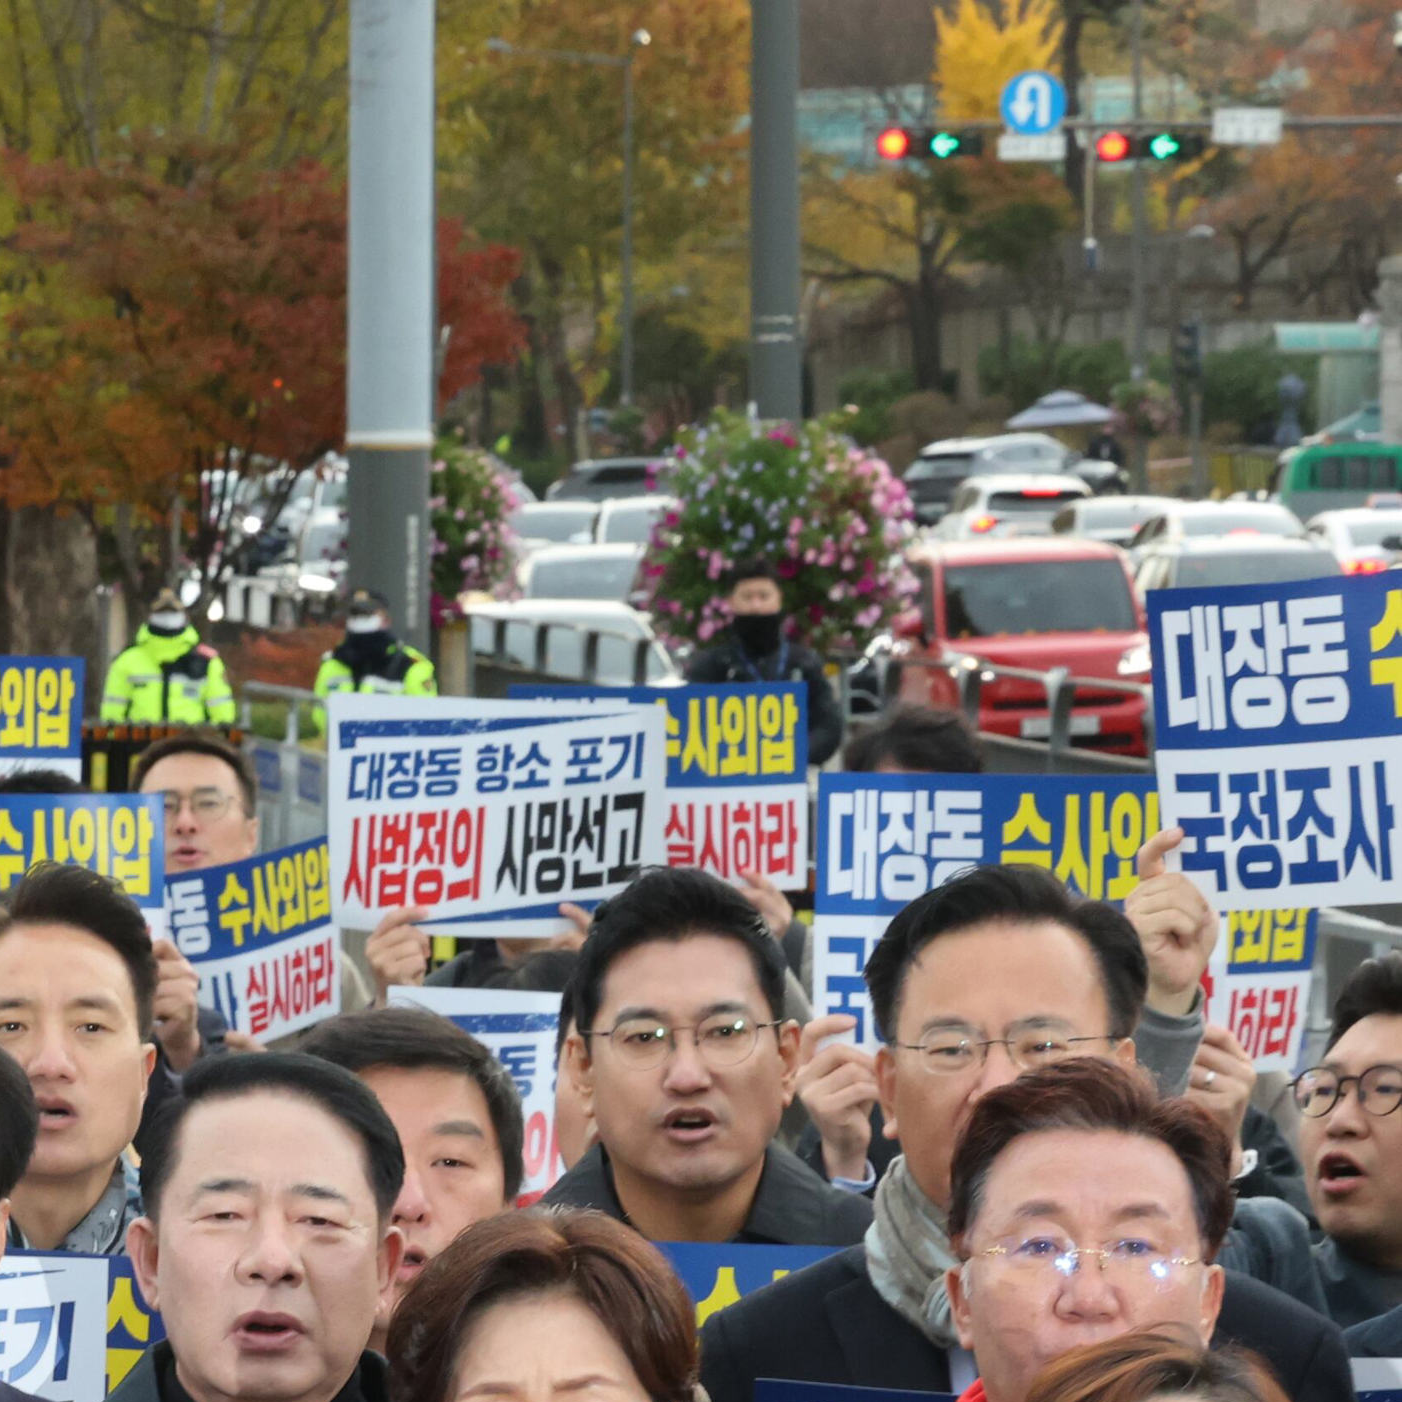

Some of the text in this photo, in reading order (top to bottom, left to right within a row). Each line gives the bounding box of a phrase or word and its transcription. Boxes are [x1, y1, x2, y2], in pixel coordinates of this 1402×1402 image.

[1161, 595, 1350, 732] 대장동
[346, 731, 646, 801] 대장동 항소 포기
[344, 791, 646, 909] 사법정의 사망선고
[664, 800, 798, 879] 실시하라
[827, 789, 1160, 900] 대장동 수사외
[1174, 760, 1396, 894] 국정조사
[218, 844, 331, 947] 수사외압
[247, 938, 334, 1034] 실시하라
